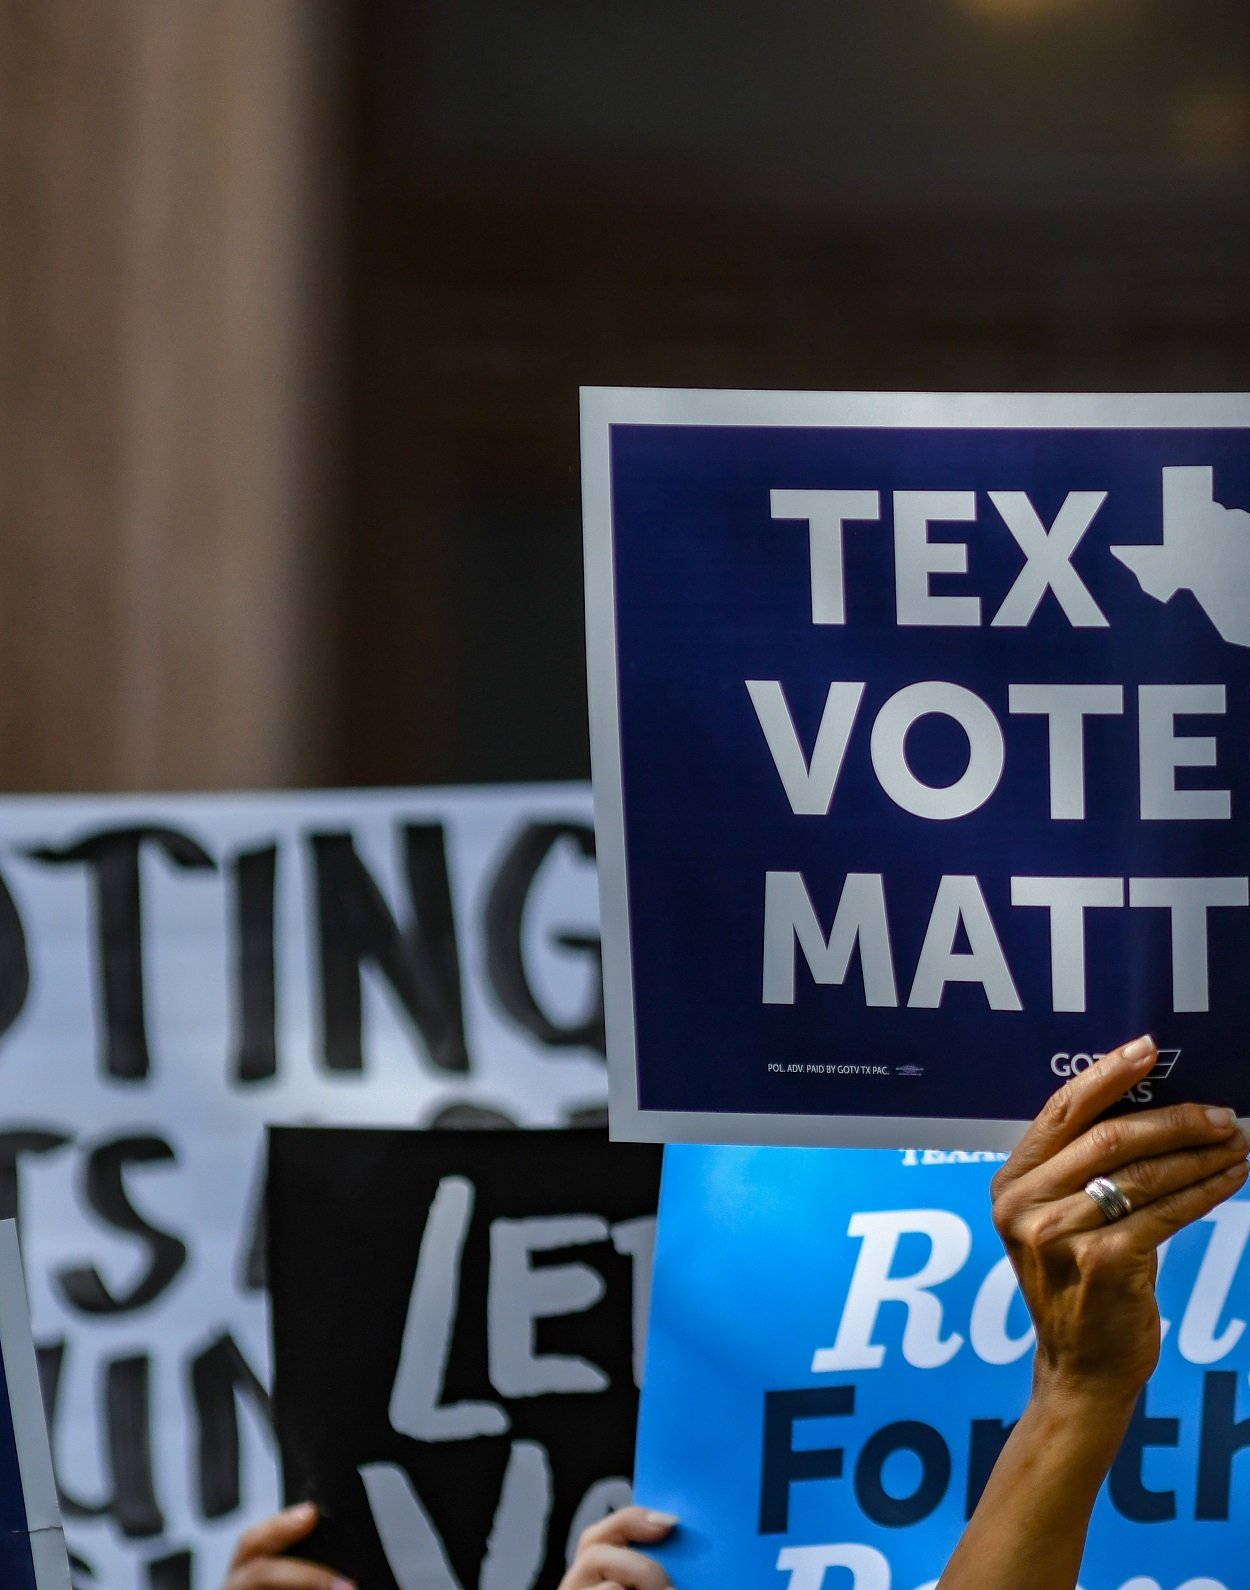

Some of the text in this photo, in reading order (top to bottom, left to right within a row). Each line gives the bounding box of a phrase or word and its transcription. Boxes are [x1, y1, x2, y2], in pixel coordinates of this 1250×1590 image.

[767, 1063, 785, 1073] POL.
[787, 1064, 805, 1073] ADV.
[806, 1064, 825, 1074] PAID
[826, 1065, 836, 1074] BY
[837, 1065, 860, 1075] GOTV
[860, 1066, 871, 1075] TX
[872, 1066, 890, 1076] PAC.
